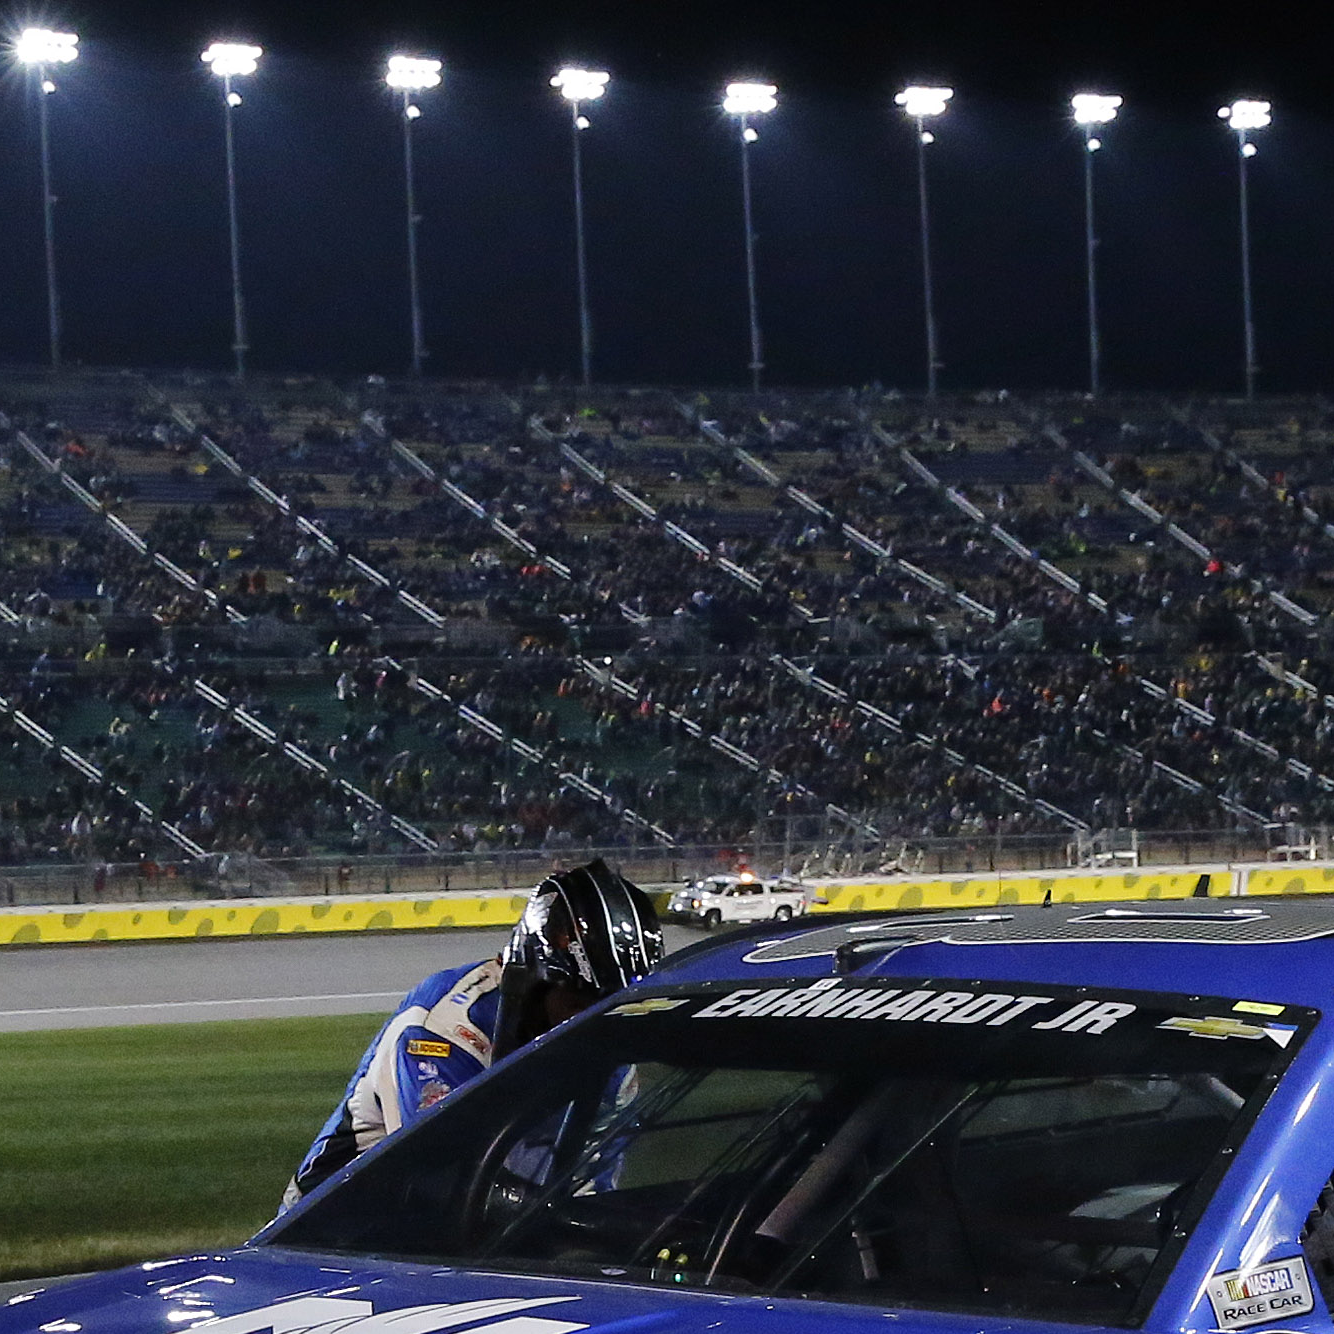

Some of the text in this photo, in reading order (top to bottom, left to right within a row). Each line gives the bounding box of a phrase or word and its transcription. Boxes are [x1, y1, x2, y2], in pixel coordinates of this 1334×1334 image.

[692, 988, 1137, 1035] EARNHARDT JR
[1246, 1267, 1293, 1298] NASCAR
[1223, 1295, 1304, 1321] RACE CAR
